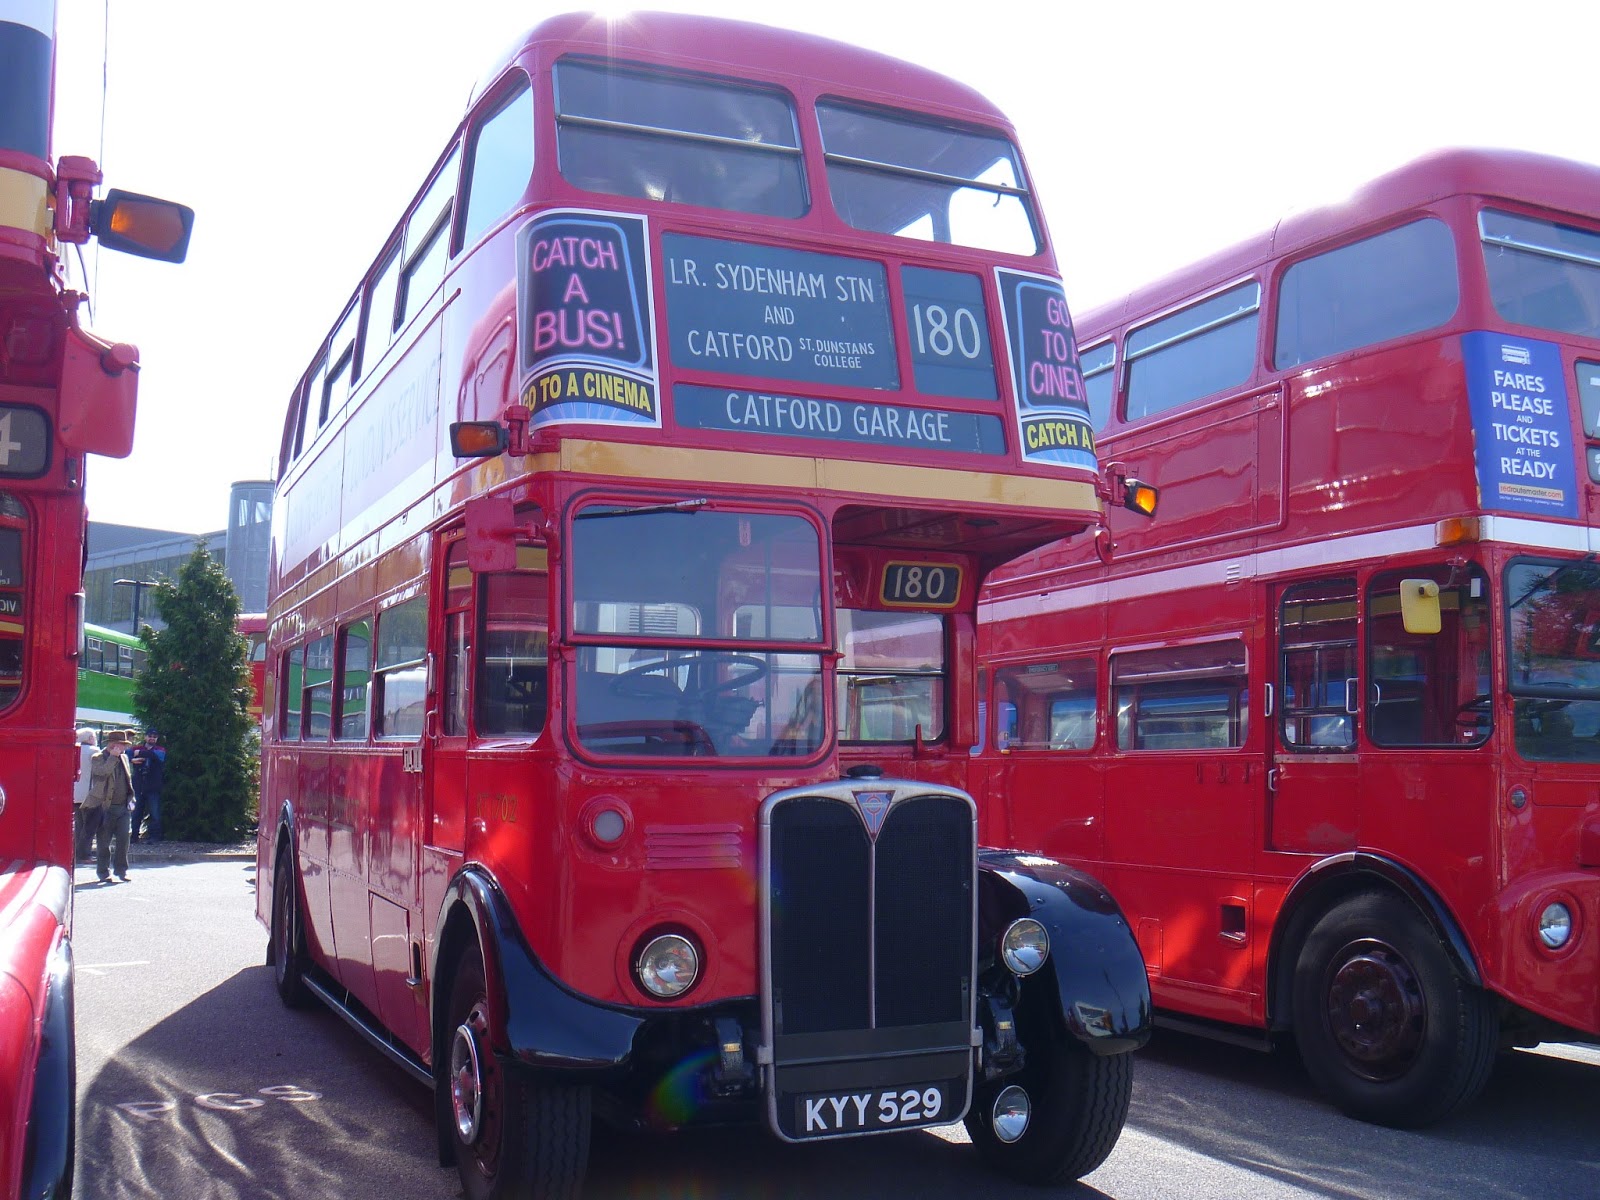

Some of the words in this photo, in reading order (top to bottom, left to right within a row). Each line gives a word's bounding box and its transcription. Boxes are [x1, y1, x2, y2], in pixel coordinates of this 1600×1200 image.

[532, 237, 618, 272] CATCH
[564, 273, 589, 304] A
[670, 258, 707, 287] LR.
[715, 263, 827, 299] SYDENHAM
[835, 276, 875, 303] STN
[764, 305, 795, 325] AND
[1047, 297, 1070, 328] GO
[533, 309, 625, 352] BUS!
[687, 330, 793, 362] CATFORD
[913, 304, 981, 359] 180
[1041, 330, 1067, 362] TO
[814, 354, 862, 369] COLLEGE
[540, 374, 561, 402] TO
[566, 372, 579, 396] A
[583, 372, 652, 412] CINEMA
[1494, 370, 1546, 393] FARES
[726, 392, 842, 433] CATFORD
[853, 405, 951, 442] GARAGE
[1491, 391, 1554, 416] PLEASE
[1516, 415, 1533, 424] AND
[1027, 422, 1078, 449] CATCH
[1082, 426, 1091, 449] A
[1492, 423, 1560, 448] TICKETS
[1501, 457, 1557, 479] READY
[1515, 447, 1525, 455] AT
[1527, 448, 1541, 458] THE
[1500, 485, 1562, 499] redroutemaster.com
[894, 566, 945, 599] 180
[806, 1093, 872, 1132] KYY
[878, 1087, 942, 1123] 529
